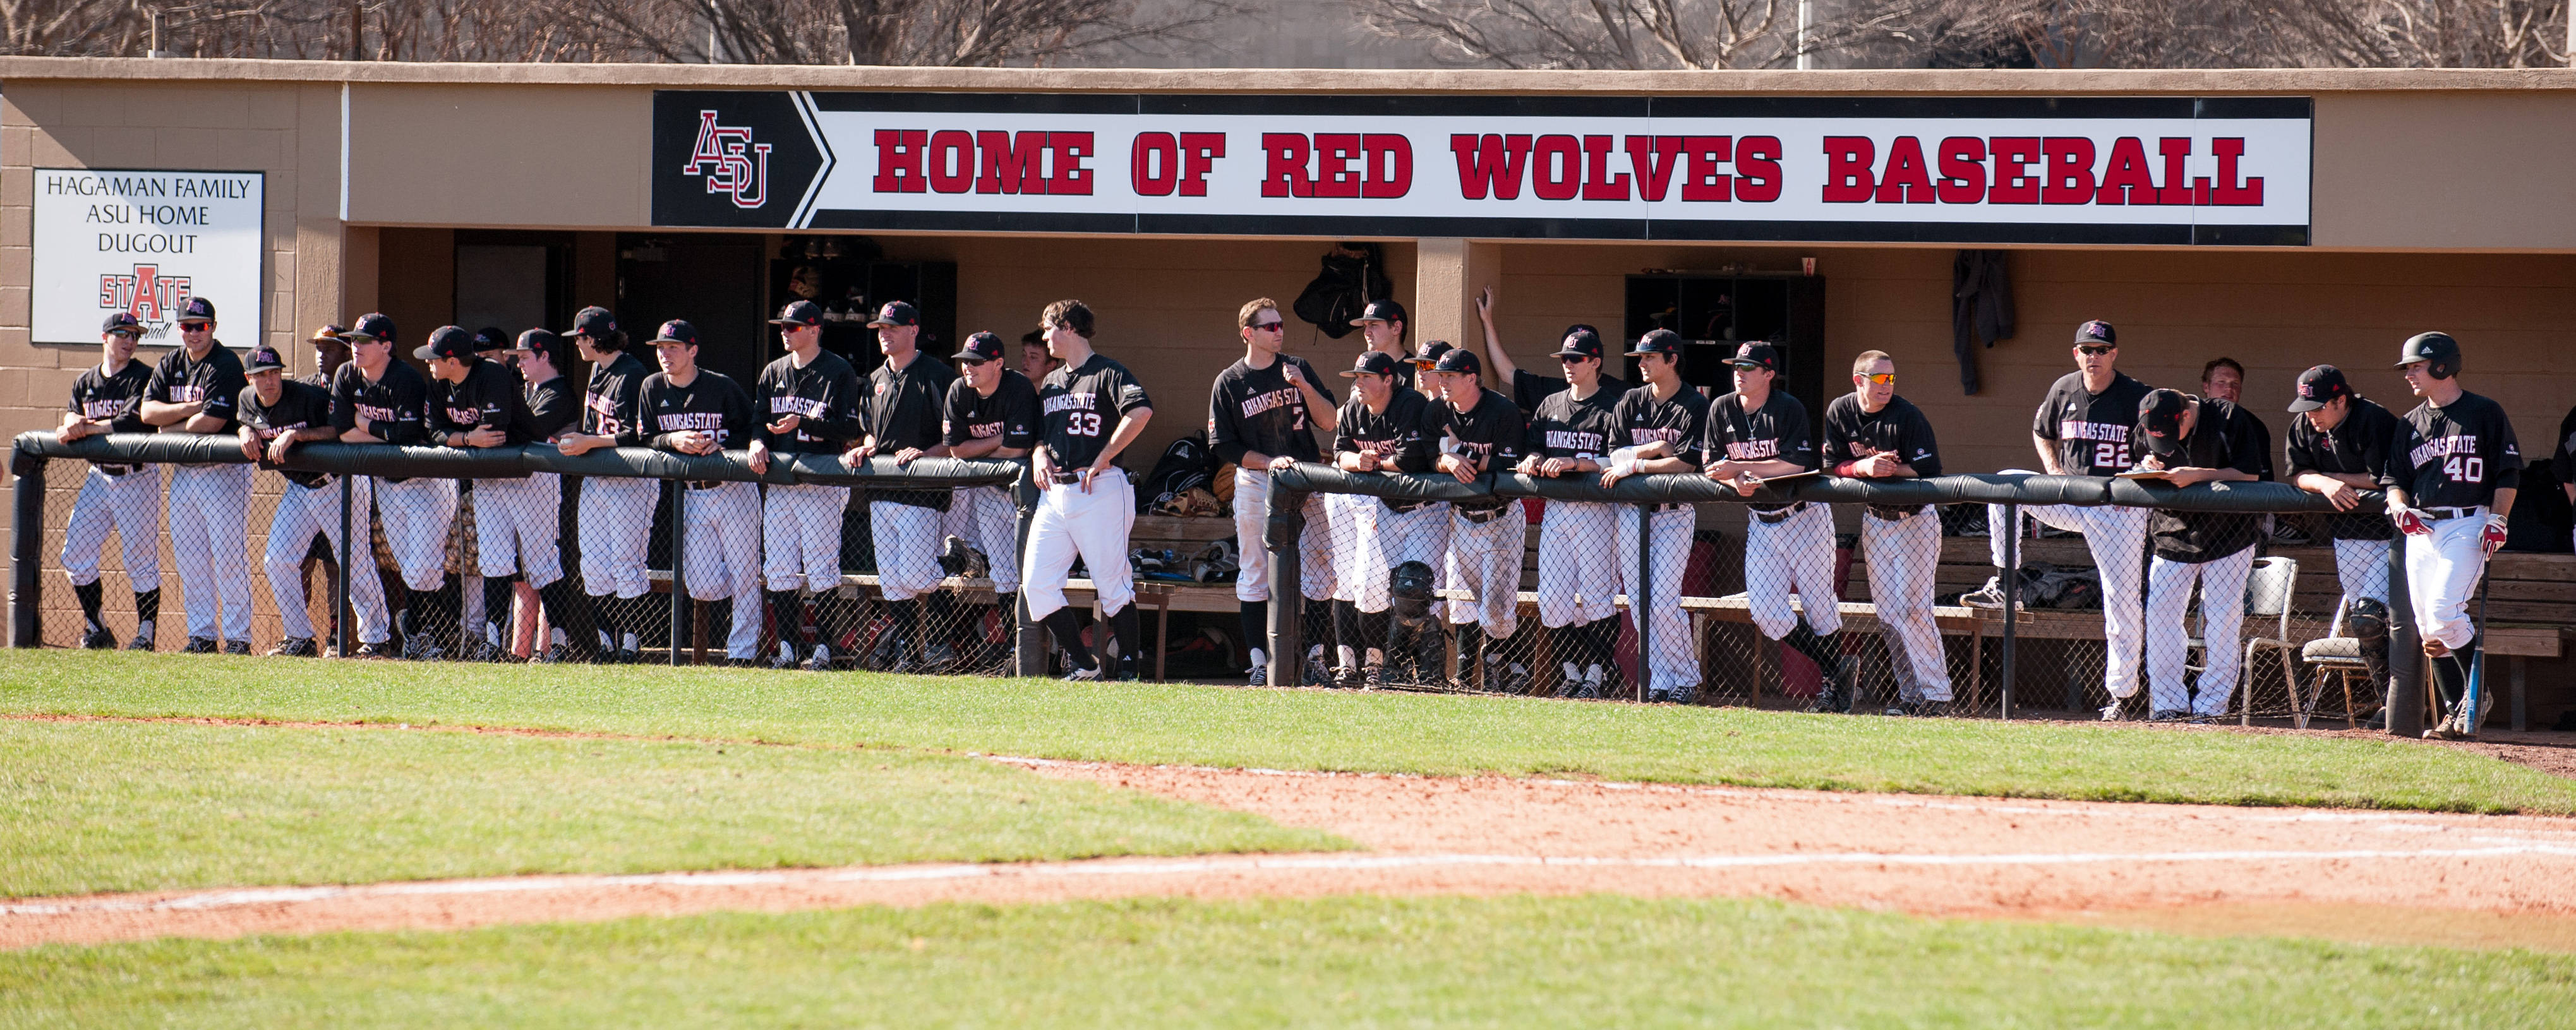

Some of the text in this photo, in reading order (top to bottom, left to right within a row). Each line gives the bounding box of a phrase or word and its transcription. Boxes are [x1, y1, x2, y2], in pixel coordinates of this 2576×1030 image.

[683, 109, 772, 208] ASU
[873, 129, 2265, 207] HOME OF RED WOLVES BASEBALL
[47, 176, 251, 199] HAGAMAN FAMILY
[86, 204, 210, 225] ASU HOME
[98, 233, 198, 254] DUGOUT
[771, 395, 804, 414] RKANSAS
[1073, 393, 1096, 410] STATE
[1241, 387, 1303, 419] ARKANSAS STA
[658, 412, 723, 431] KANSAS STATE
[1067, 412, 1102, 437] 33
[1292, 407, 1305, 431] 7
[1578, 431, 1603, 452] STATE
[2061, 420, 2129, 443] ANSAS STATE
[2095, 443, 2132, 467] 22
[2409, 435, 2476, 470] ARKANSAS STATE
[2443, 457, 2484, 483] 40
